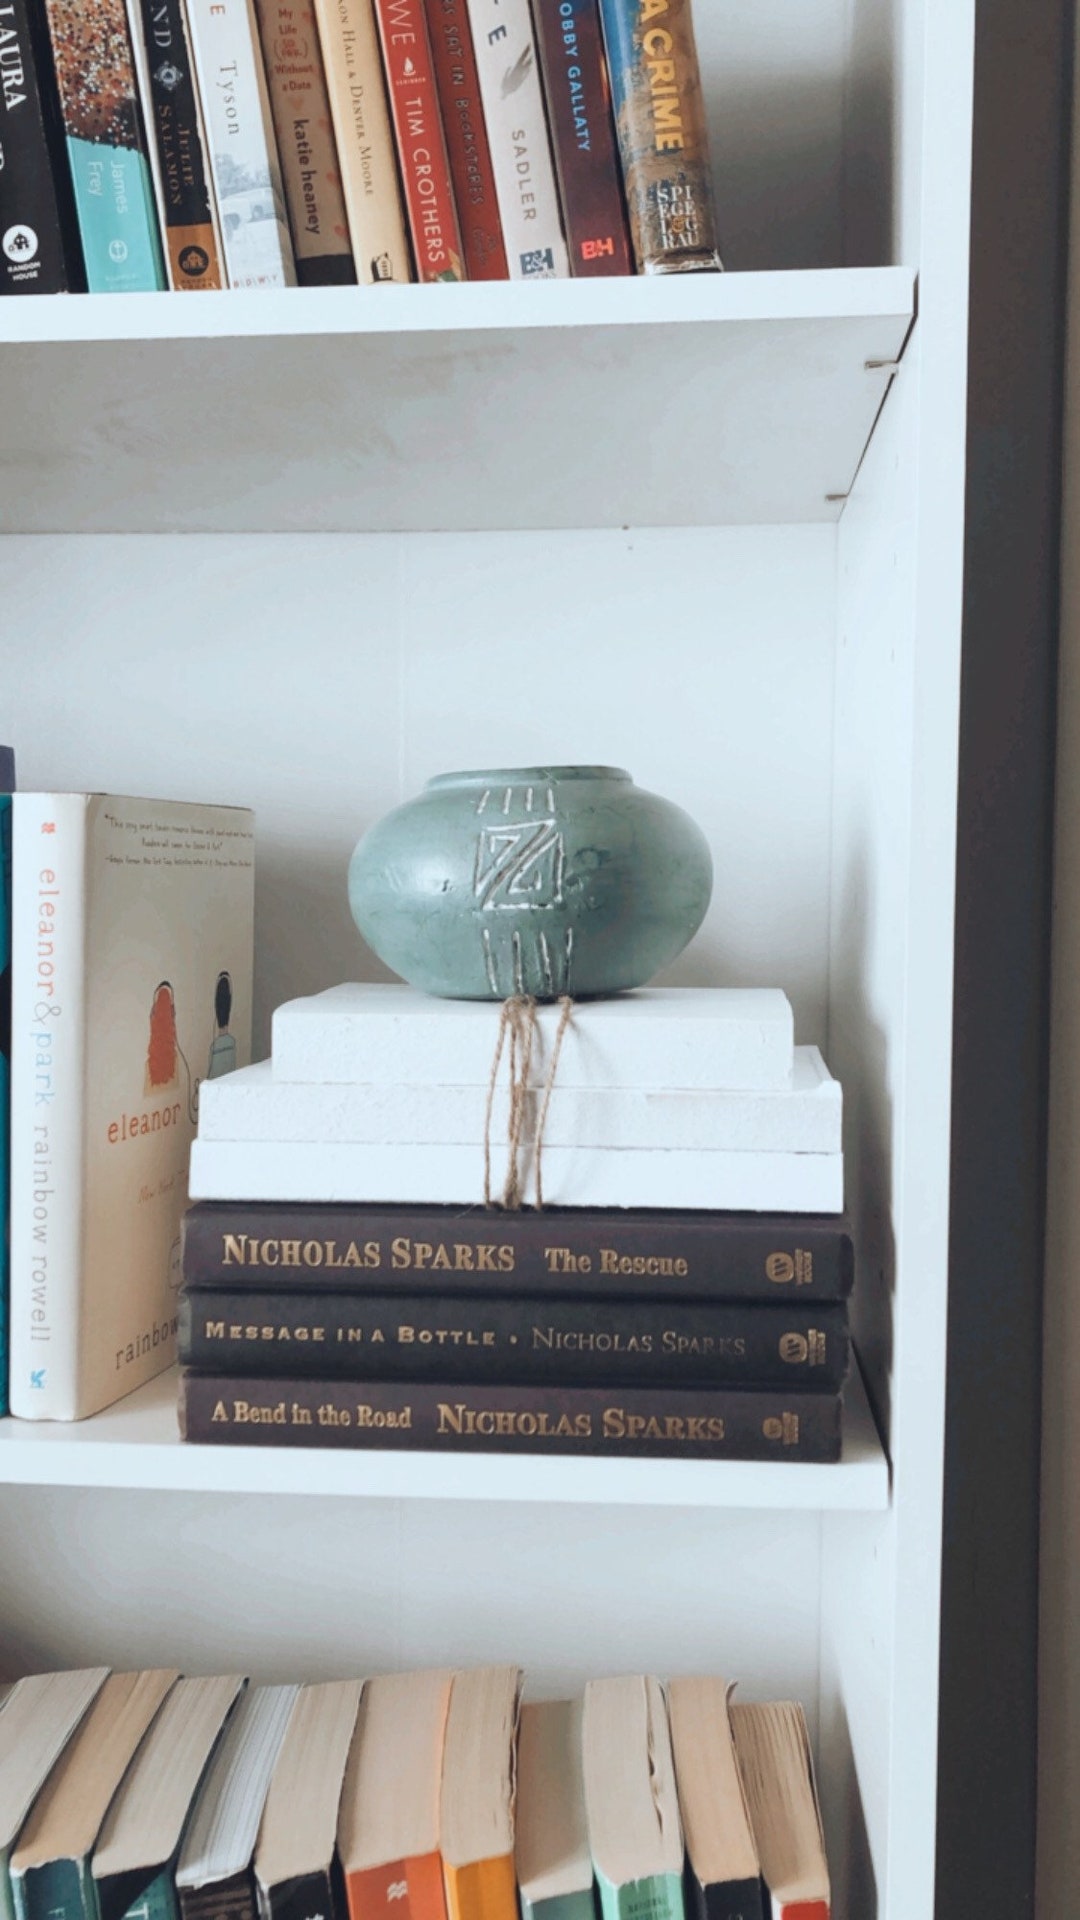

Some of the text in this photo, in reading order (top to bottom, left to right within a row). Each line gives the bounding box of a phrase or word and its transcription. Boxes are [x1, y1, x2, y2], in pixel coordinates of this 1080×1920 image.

[342, 30, 356, 65] HALL
[274, 65, 314, 74] Without
[288, 81, 311, 91] Date
[452, 66, 464, 85] IN
[559, 3, 590, 152] OBBY GALLATY
[640, 0, 684, 150] A CRIME
[216, 60, 240, 136] Tyson
[88, 161, 103, 196] Frey
[110, 160, 128, 214] James
[293, 119, 320, 234] katie heaney
[405, 97, 445, 262] TIM CROTHERS
[512, 130, 536, 221] SADLER
[7, 261, 41, 272] RANDOM
[12, 270, 38, 281] HOUSE
[107, 1103, 181, 1144] eleanor
[32, 1126, 54, 1244] rainbow
[222, 1234, 689, 1277] NICHOLAS SPARKS The Rescue
[30, 1256, 51, 1342] rowell
[206, 1321, 325, 1341] MESSAGE
[337, 1326, 362, 1342] IN
[371, 1328, 384, 1343] A
[398, 1326, 495, 1346] BOTTLE
[532, 1327, 653, 1352] NICHOLAS
[211, 1401, 725, 1440] A Bend in the Road NICHOLAS SPARKS
